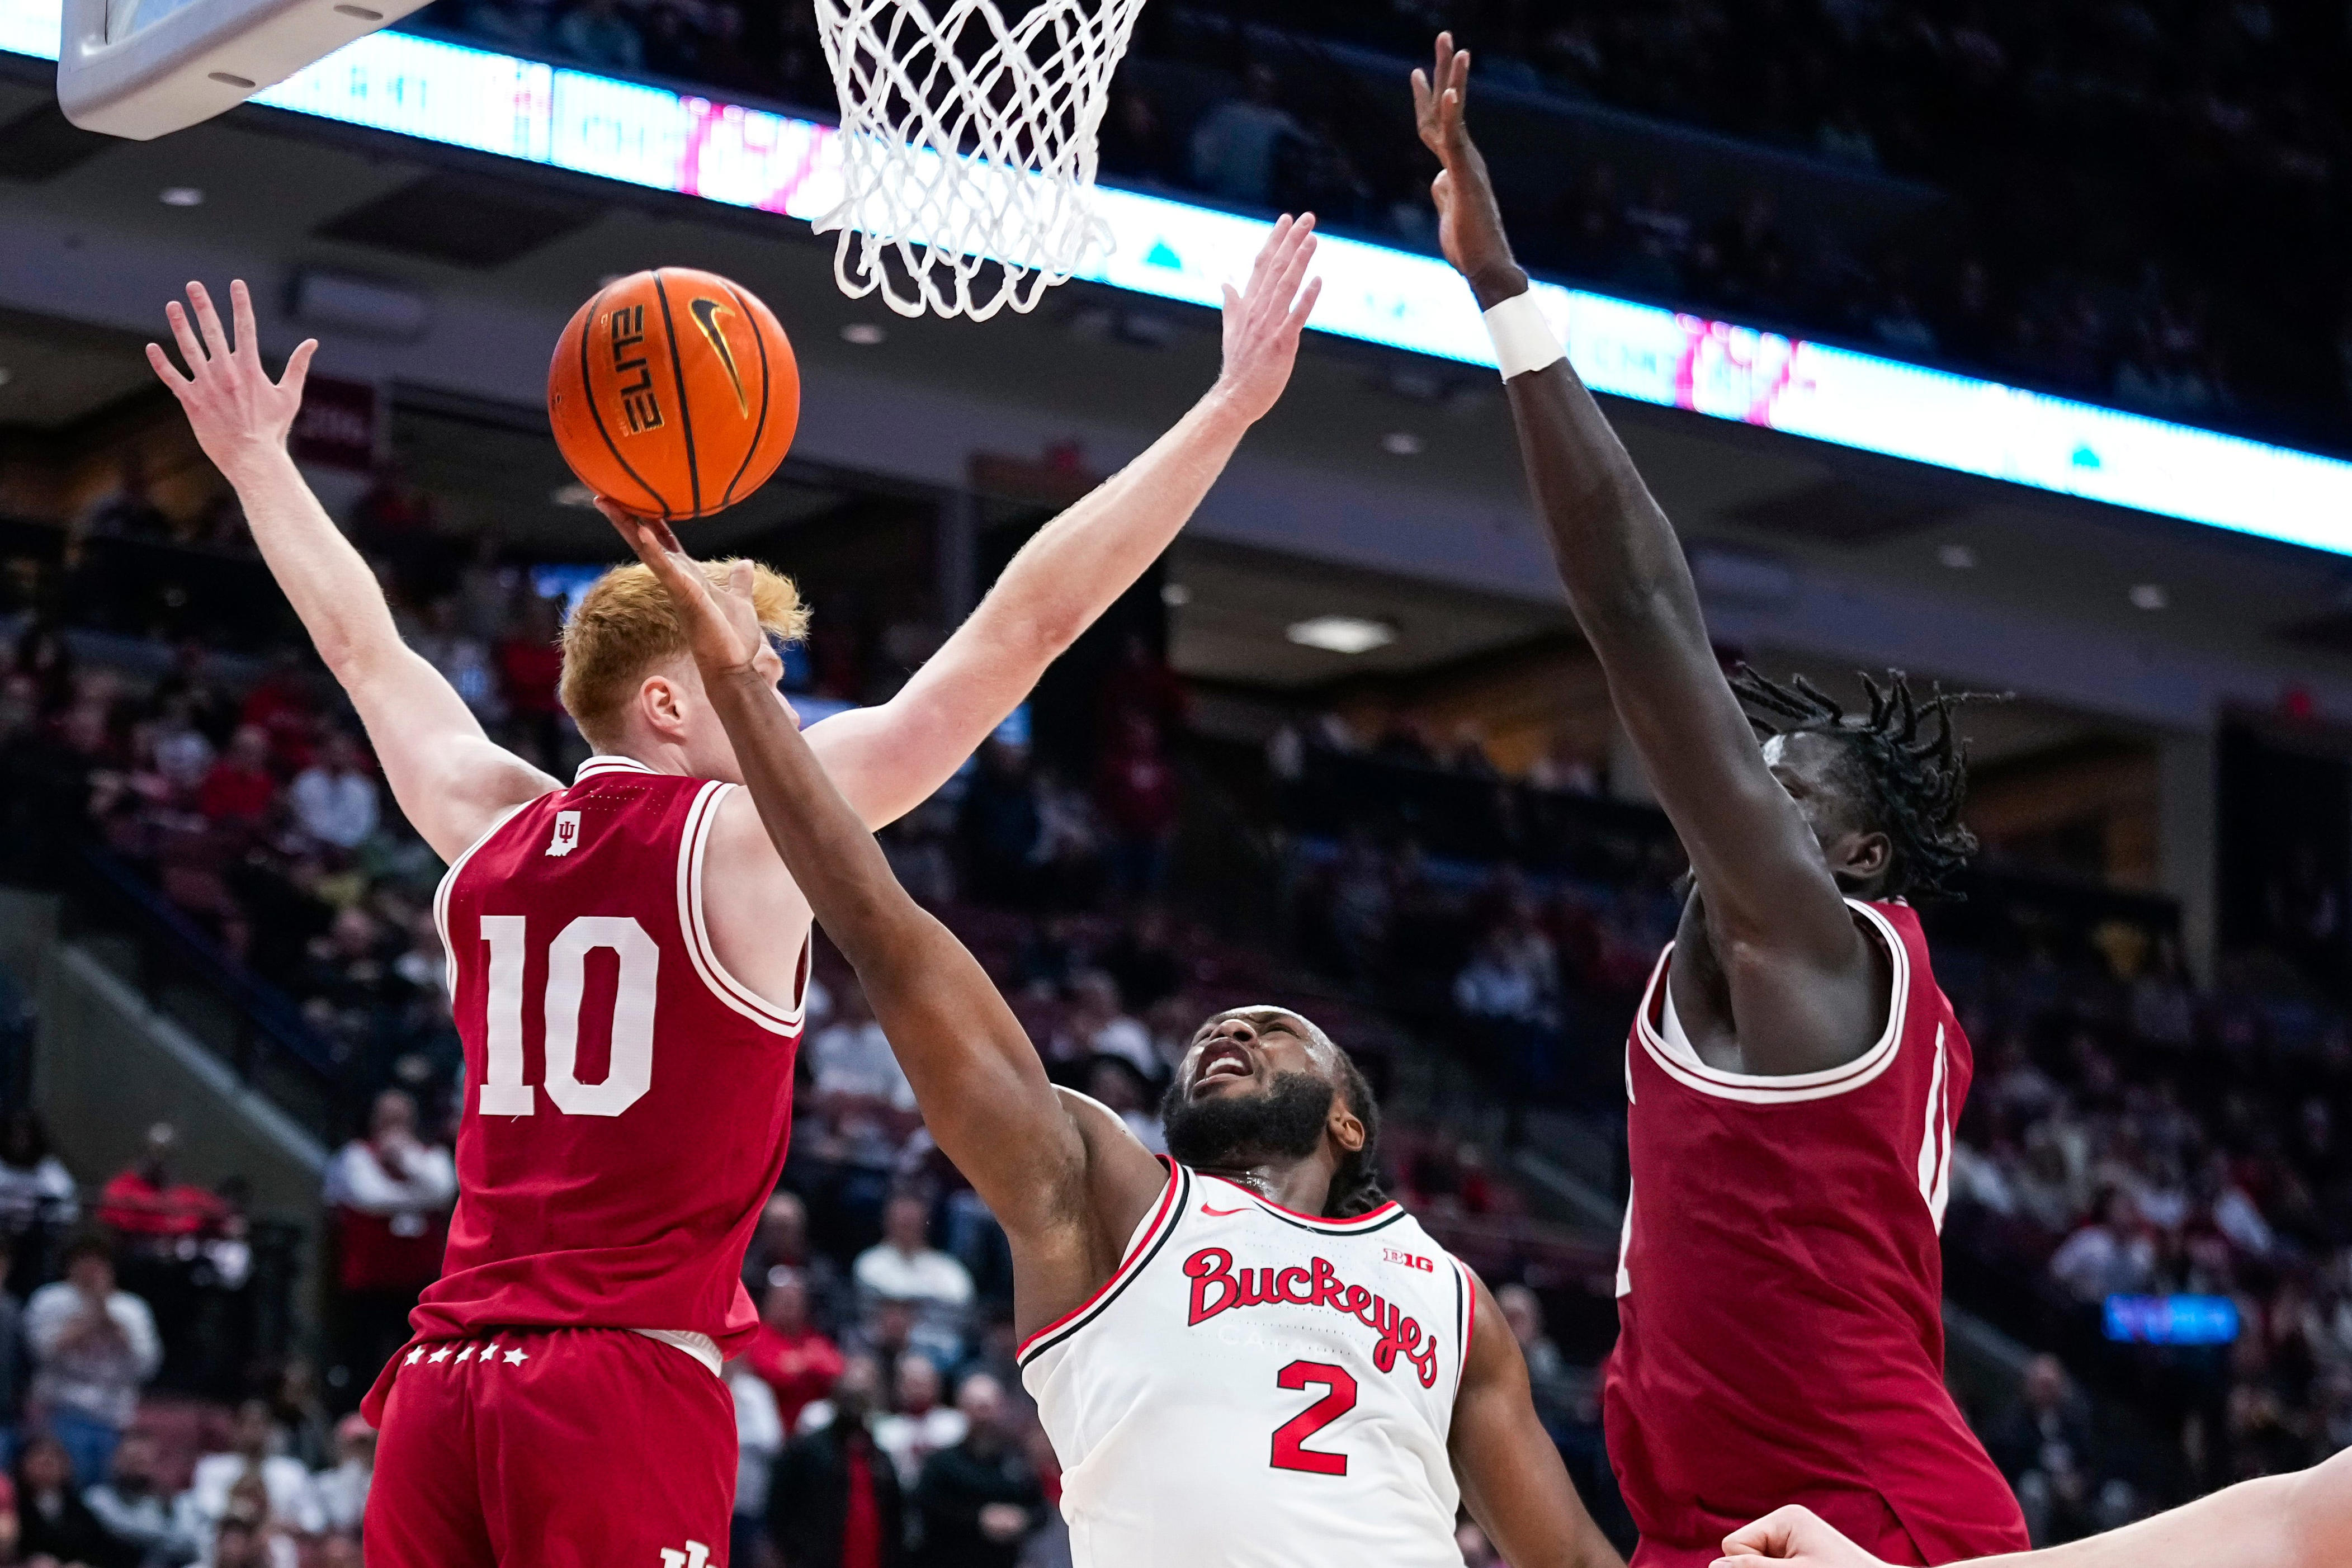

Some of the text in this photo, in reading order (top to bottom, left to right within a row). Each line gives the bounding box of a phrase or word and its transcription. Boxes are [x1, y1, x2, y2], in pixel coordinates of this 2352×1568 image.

[611, 303, 664, 435] ELITE
[479, 915, 660, 1117] 10
[1182, 1247, 1438, 1389] Buckeyes
[1269, 1359, 1358, 1476] 2
